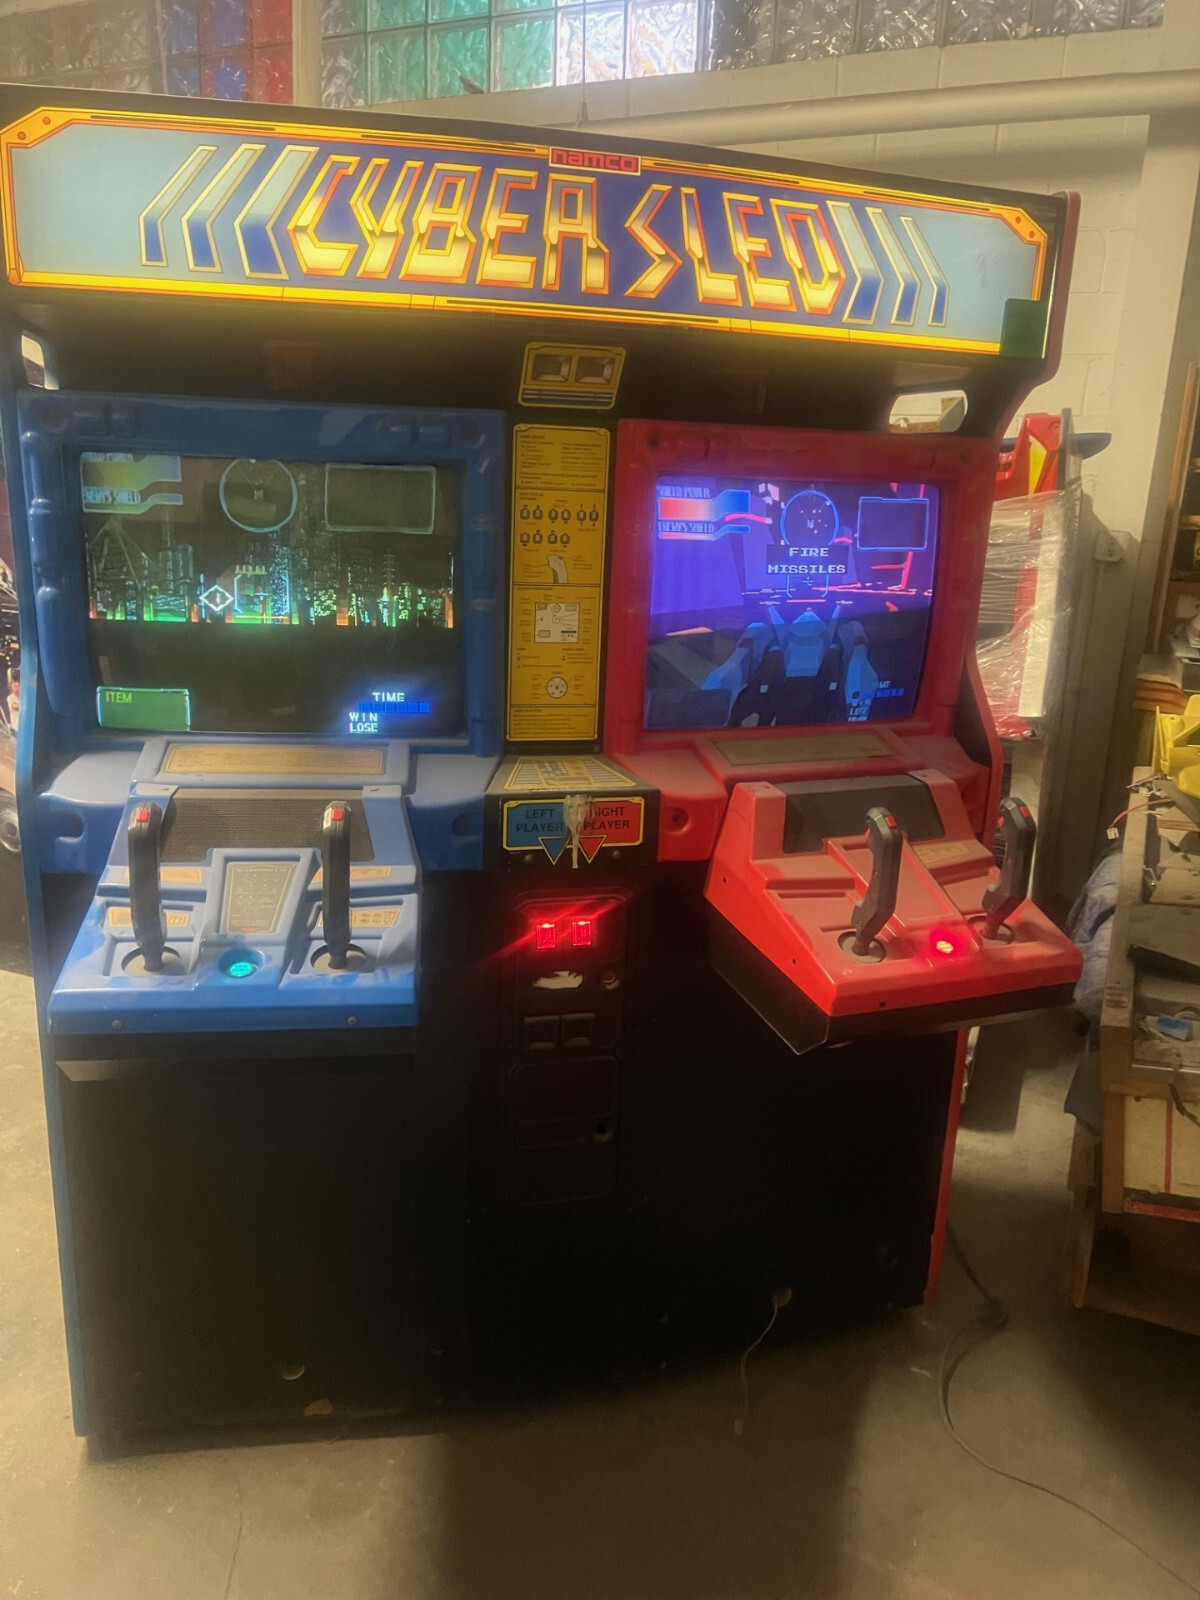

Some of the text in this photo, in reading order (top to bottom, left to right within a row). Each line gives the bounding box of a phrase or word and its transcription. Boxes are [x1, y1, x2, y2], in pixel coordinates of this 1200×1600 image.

[552, 149, 637, 172] namco
[287, 154, 846, 315] CYBER SLED
[788, 547, 829, 557] FIRE
[767, 564, 846, 574] MISSILES
[105, 691, 133, 703] ITEM
[372, 692, 405, 702] TIME
[348, 712, 378, 722] WIN
[349, 722, 378, 733] LOSE
[525, 808, 555, 819] LEFT
[516, 822, 563, 832] PLAYER
[583, 819, 630, 831] PLAYER
